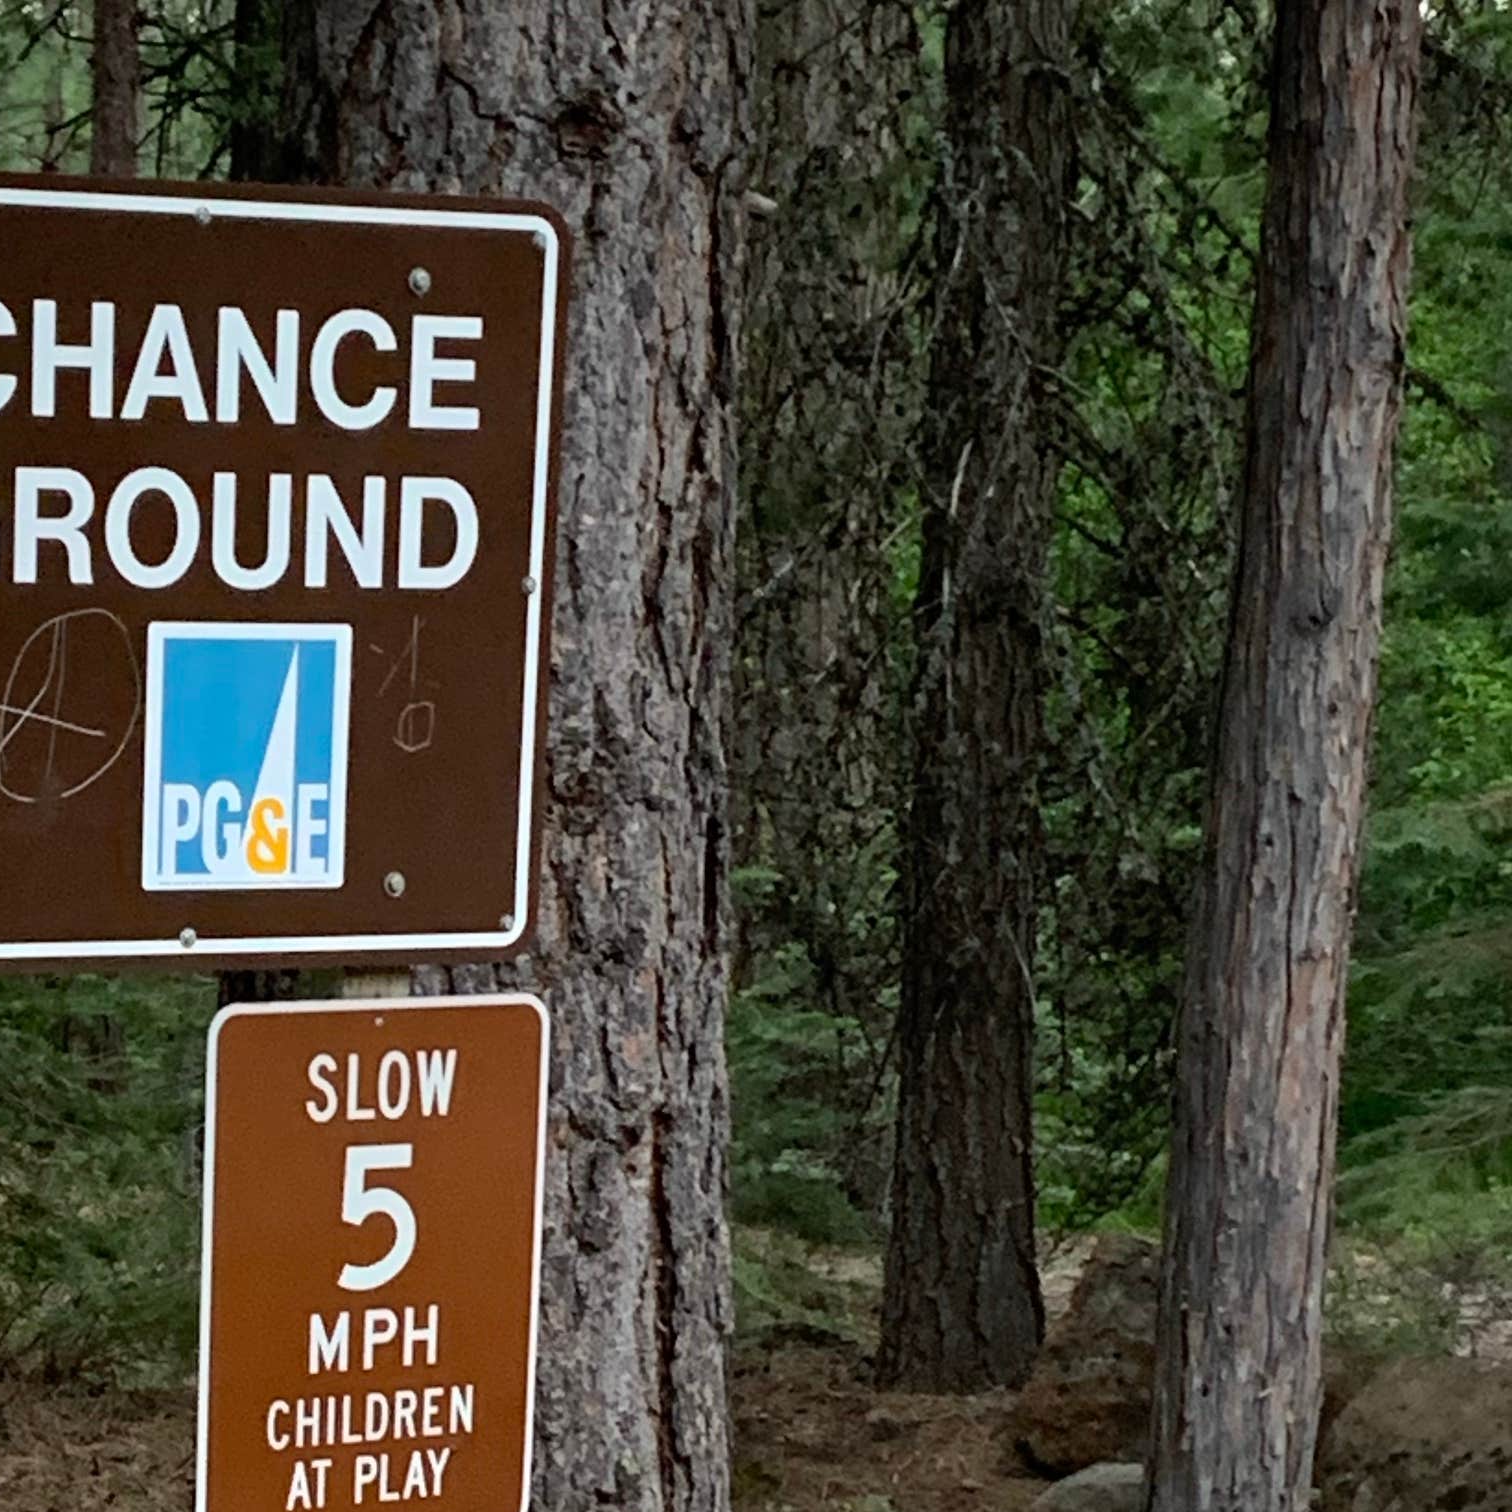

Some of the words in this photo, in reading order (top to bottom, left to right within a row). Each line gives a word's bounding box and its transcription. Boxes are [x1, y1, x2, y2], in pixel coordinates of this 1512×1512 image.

[161, 780, 329, 875] PG&E
[305, 1049, 457, 1123] SLOW
[337, 1143, 417, 1291] 5
[308, 1304, 439, 1375] MPH
[266, 1384, 474, 1451] CHILDREN
[285, 1458, 333, 1512] AT
[354, 1447, 451, 1504] PLAY
